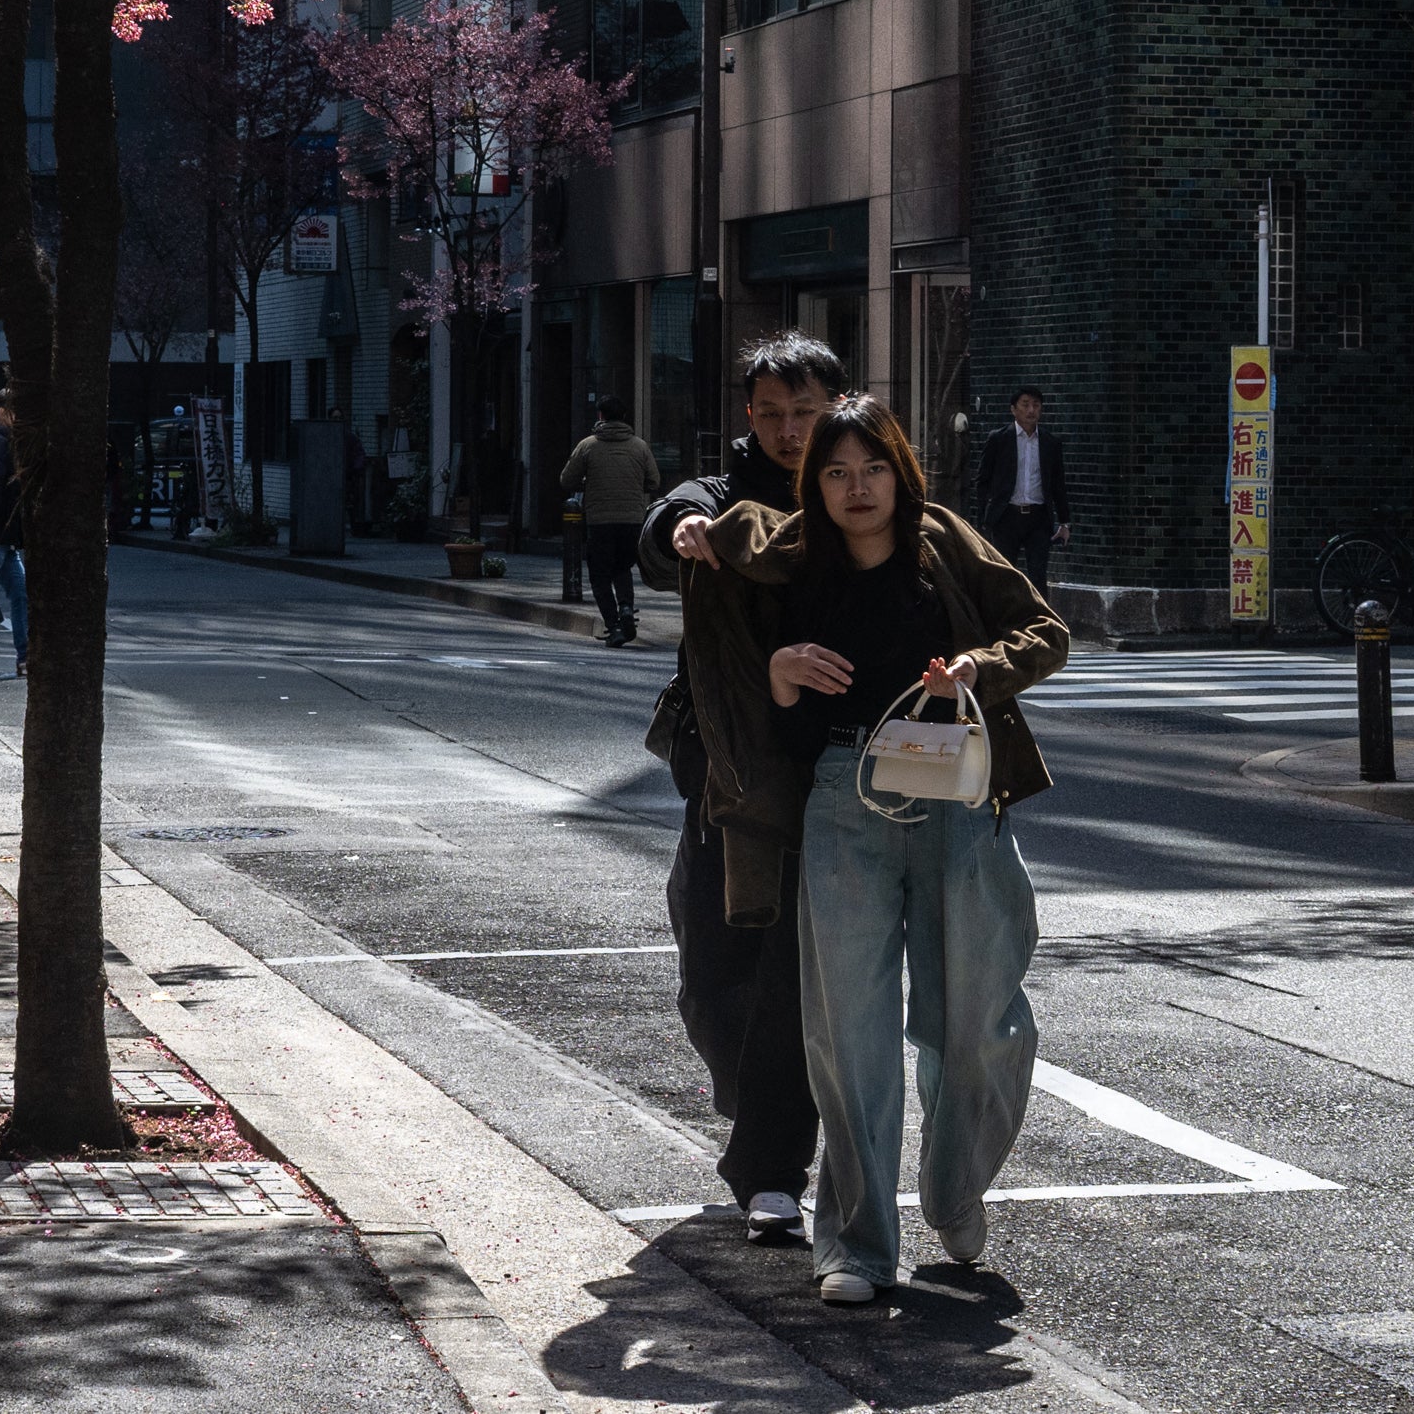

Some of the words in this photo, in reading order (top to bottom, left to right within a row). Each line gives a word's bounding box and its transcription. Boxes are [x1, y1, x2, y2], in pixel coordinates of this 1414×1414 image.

[202, 413, 230, 509] 日本橋カフェ
[1232, 421, 1254, 614] 右折進入禁止
